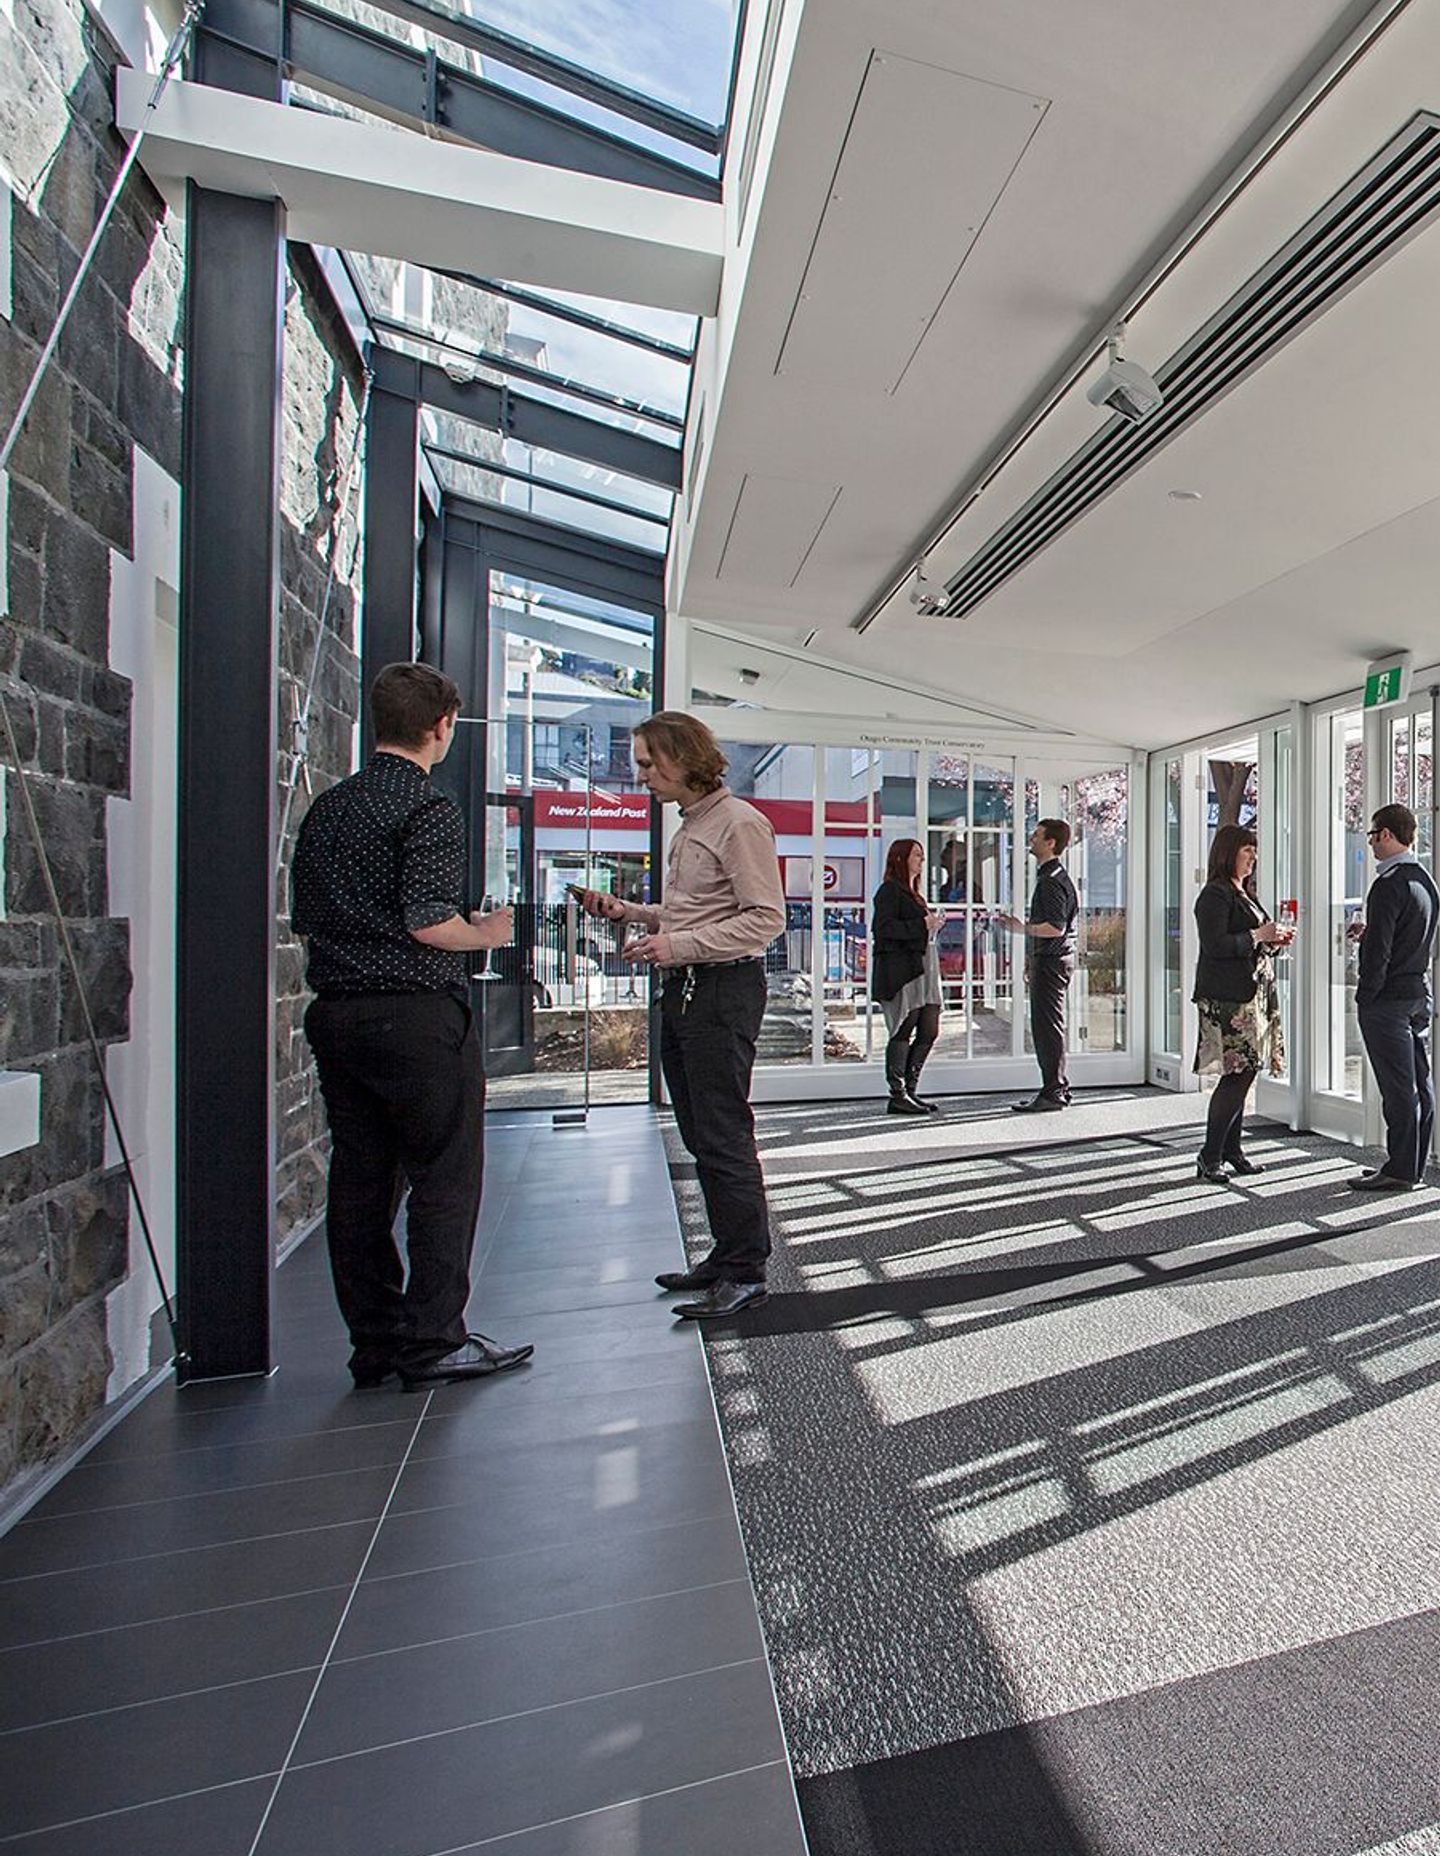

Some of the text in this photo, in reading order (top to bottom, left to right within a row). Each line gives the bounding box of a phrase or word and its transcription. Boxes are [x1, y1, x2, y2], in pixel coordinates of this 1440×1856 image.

[548, 805, 647, 818] New Zealand Post
